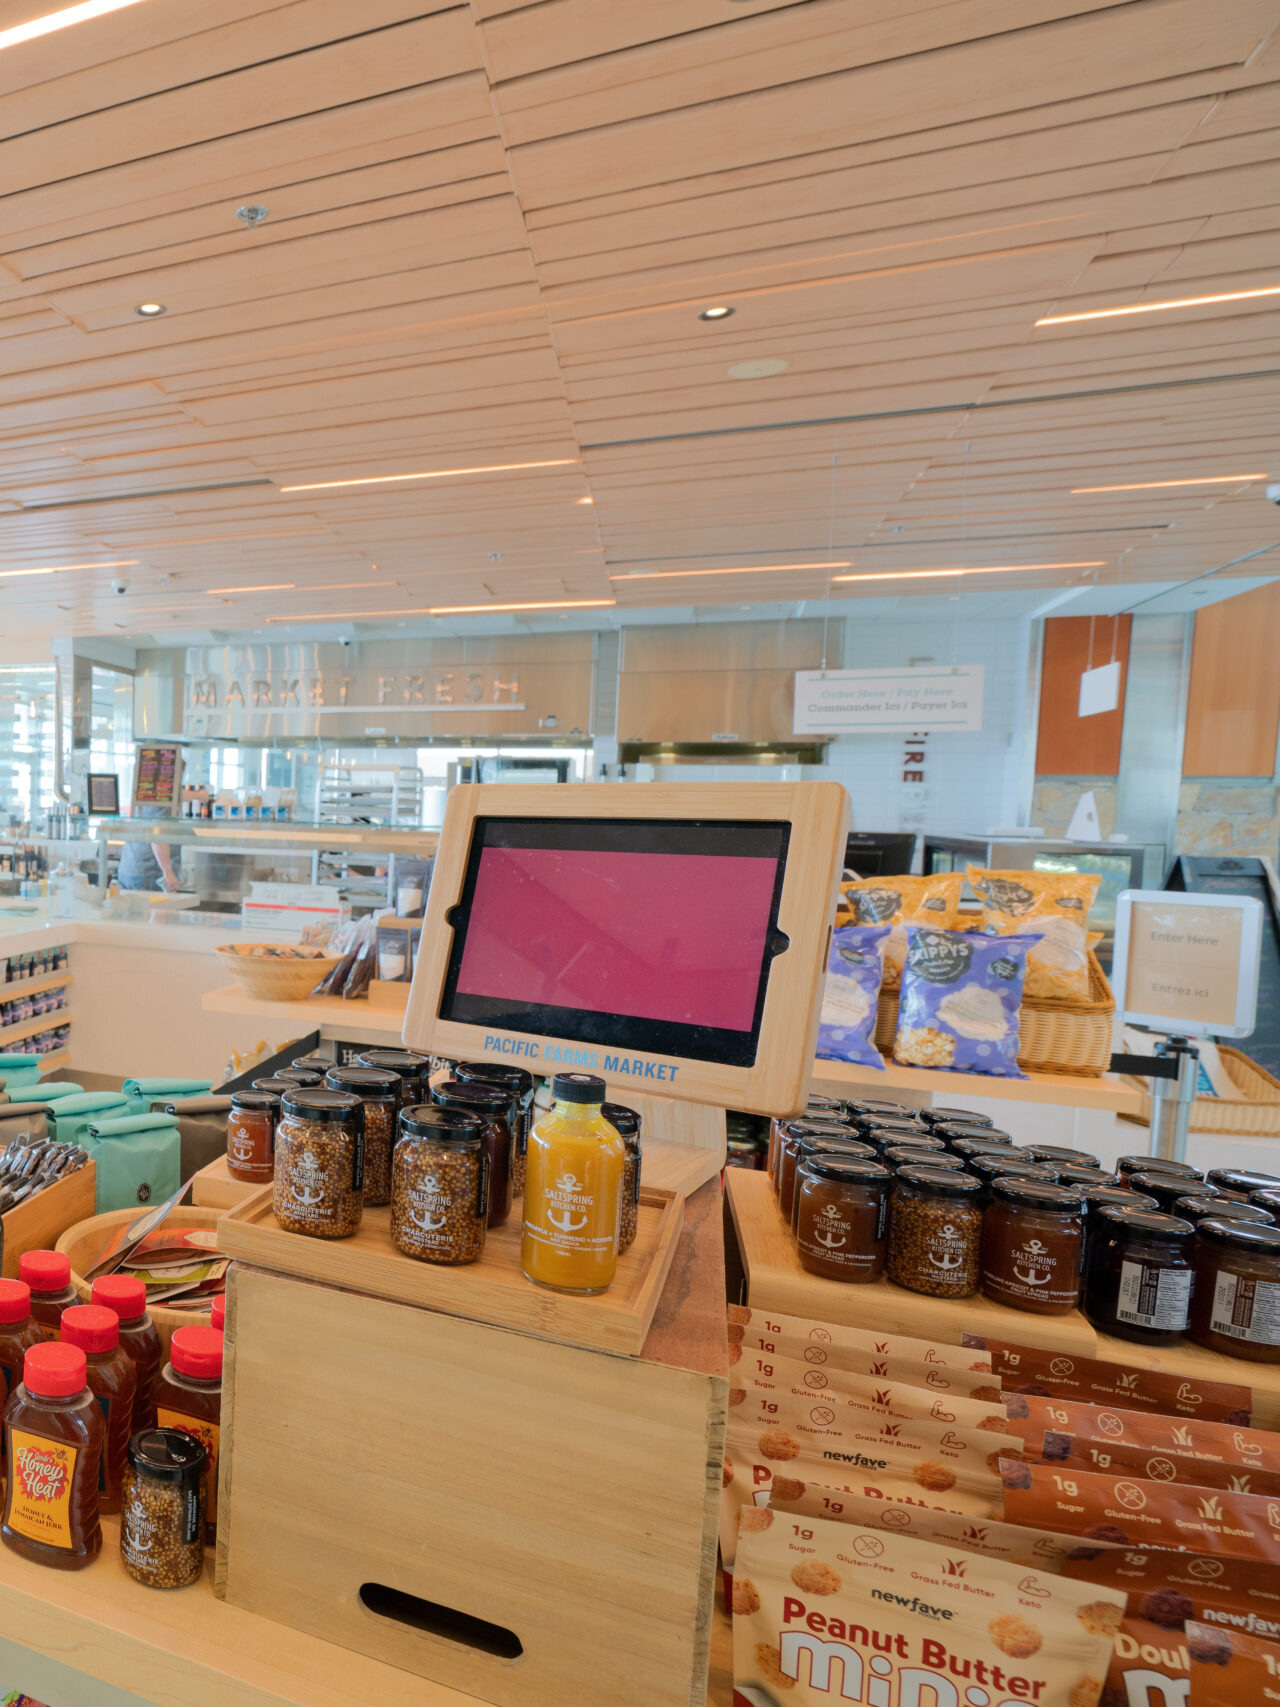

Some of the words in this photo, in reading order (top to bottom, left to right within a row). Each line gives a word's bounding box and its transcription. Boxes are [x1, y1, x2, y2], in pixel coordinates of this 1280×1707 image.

[193, 675, 356, 708] MARKET
[377, 672, 519, 706] FRESH
[820, 689, 855, 699] Order
[858, 688, 887, 698] Here
[897, 688, 920, 698] Pay
[924, 687, 954, 696] Here
[808, 703, 881, 713] Commander
[885, 702, 900, 711] Ici
[911, 701, 947, 711] Payer
[951, 700, 968, 709] Ici
[1151, 931, 1185, 944] Enter
[1187, 935, 1220, 947] Here
[1151, 982, 1192, 997] Entrez
[1194, 983, 1209, 998] ici
[484, 1035, 540, 1059] PACIFIC
[542, 1045, 599, 1070] FARMS
[603, 1055, 680, 1083] MARKET
[289, 1166, 329, 1181] SALTSPRING
[408, 1189, 452, 1206] SALTSPRING
[544, 1187, 593, 1206] SALTSPRING
[551, 1200, 576, 1211] KITCHEN
[813, 1214, 851, 1230] SALTSPRING
[402, 1225, 454, 1242] CHARCUTERIE
[926, 1236, 968, 1249] SALTSPRING
[932, 1245, 954, 1254] KITCHEN
[1011, 1249, 1057, 1266] SALTSPRING
[1016, 1259, 1041, 1269] KITCHEN
[918, 1266, 969, 1278] CHARCUTERIE
[1005, 1280, 1029, 1290] APRICOT
[758, 1339, 775, 1353] 1g
[1002, 1350, 1021, 1365] 1g
[756, 1360, 774, 1377] 1g
[998, 1367, 1020, 1377] Sugar
[754, 1379, 776, 1390] Sugar
[1035, 1374, 1080, 1387] Gluten-Free
[791, 1388, 837, 1403] Gluten-Free
[1091, 1383, 1114, 1394] Grass
[1115, 1388, 1131, 1398] Fed
[1132, 1392, 1159, 1404] Butter
[760, 1400, 778, 1413] 1g
[847, 1400, 870, 1411] Grass
[871, 1405, 887, 1415] Fed
[888, 1409, 913, 1420] Butter
[1176, 1403, 1195, 1413] Keto
[757, 1416, 780, 1426] Sugar
[1046, 1406, 1069, 1424] 1g
[796, 1424, 843, 1438] Gluten-Free
[855, 1433, 877, 1443] Grass
[878, 1437, 894, 1446] Fed
[895, 1440, 922, 1451] Butter
[823, 1448, 887, 1470] newfave
[939, 1449, 959, 1459] Keto
[1090, 1449, 1111, 1468] 1g
[1241, 1456, 1263, 1467] Keto
[17, 1447, 63, 1481] Honey
[23, 1470, 60, 1497] Heat
[1053, 1475, 1078, 1497] 1g
[23, 1506, 44, 1518] HONEY
[47, 1514, 55, 1522] &
[823, 1497, 844, 1515] 1g
[1056, 1500, 1086, 1513] Sugar
[15, 1508, 44, 1525] JAMAICAN
[45, 1521, 63, 1530] JERK
[1104, 1508, 1162, 1525] Gluten-Free
[792, 1524, 815, 1541] 1g
[1175, 1518, 1202, 1531] Grass
[1203, 1522, 1222, 1534] Fed
[1223, 1526, 1255, 1539] Butter
[788, 1543, 816, 1555] Sugar
[836, 1553, 896, 1574] Gluten-Free
[1123, 1551, 1149, 1566] 1g
[1115, 1568, 1147, 1577] Sugar
[910, 1571, 940, 1586] Grass
[941, 1576, 961, 1590] Fed
[962, 1583, 997, 1600] Butter
[1166, 1574, 1233, 1592] Gluten-Free
[870, 1588, 954, 1621] newfave
[1018, 1598, 1043, 1611] Keto
[917, 1611, 941, 1622] FOODS
[782, 1596, 910, 1660] Peanut
[921, 1637, 1048, 1701] Butter
